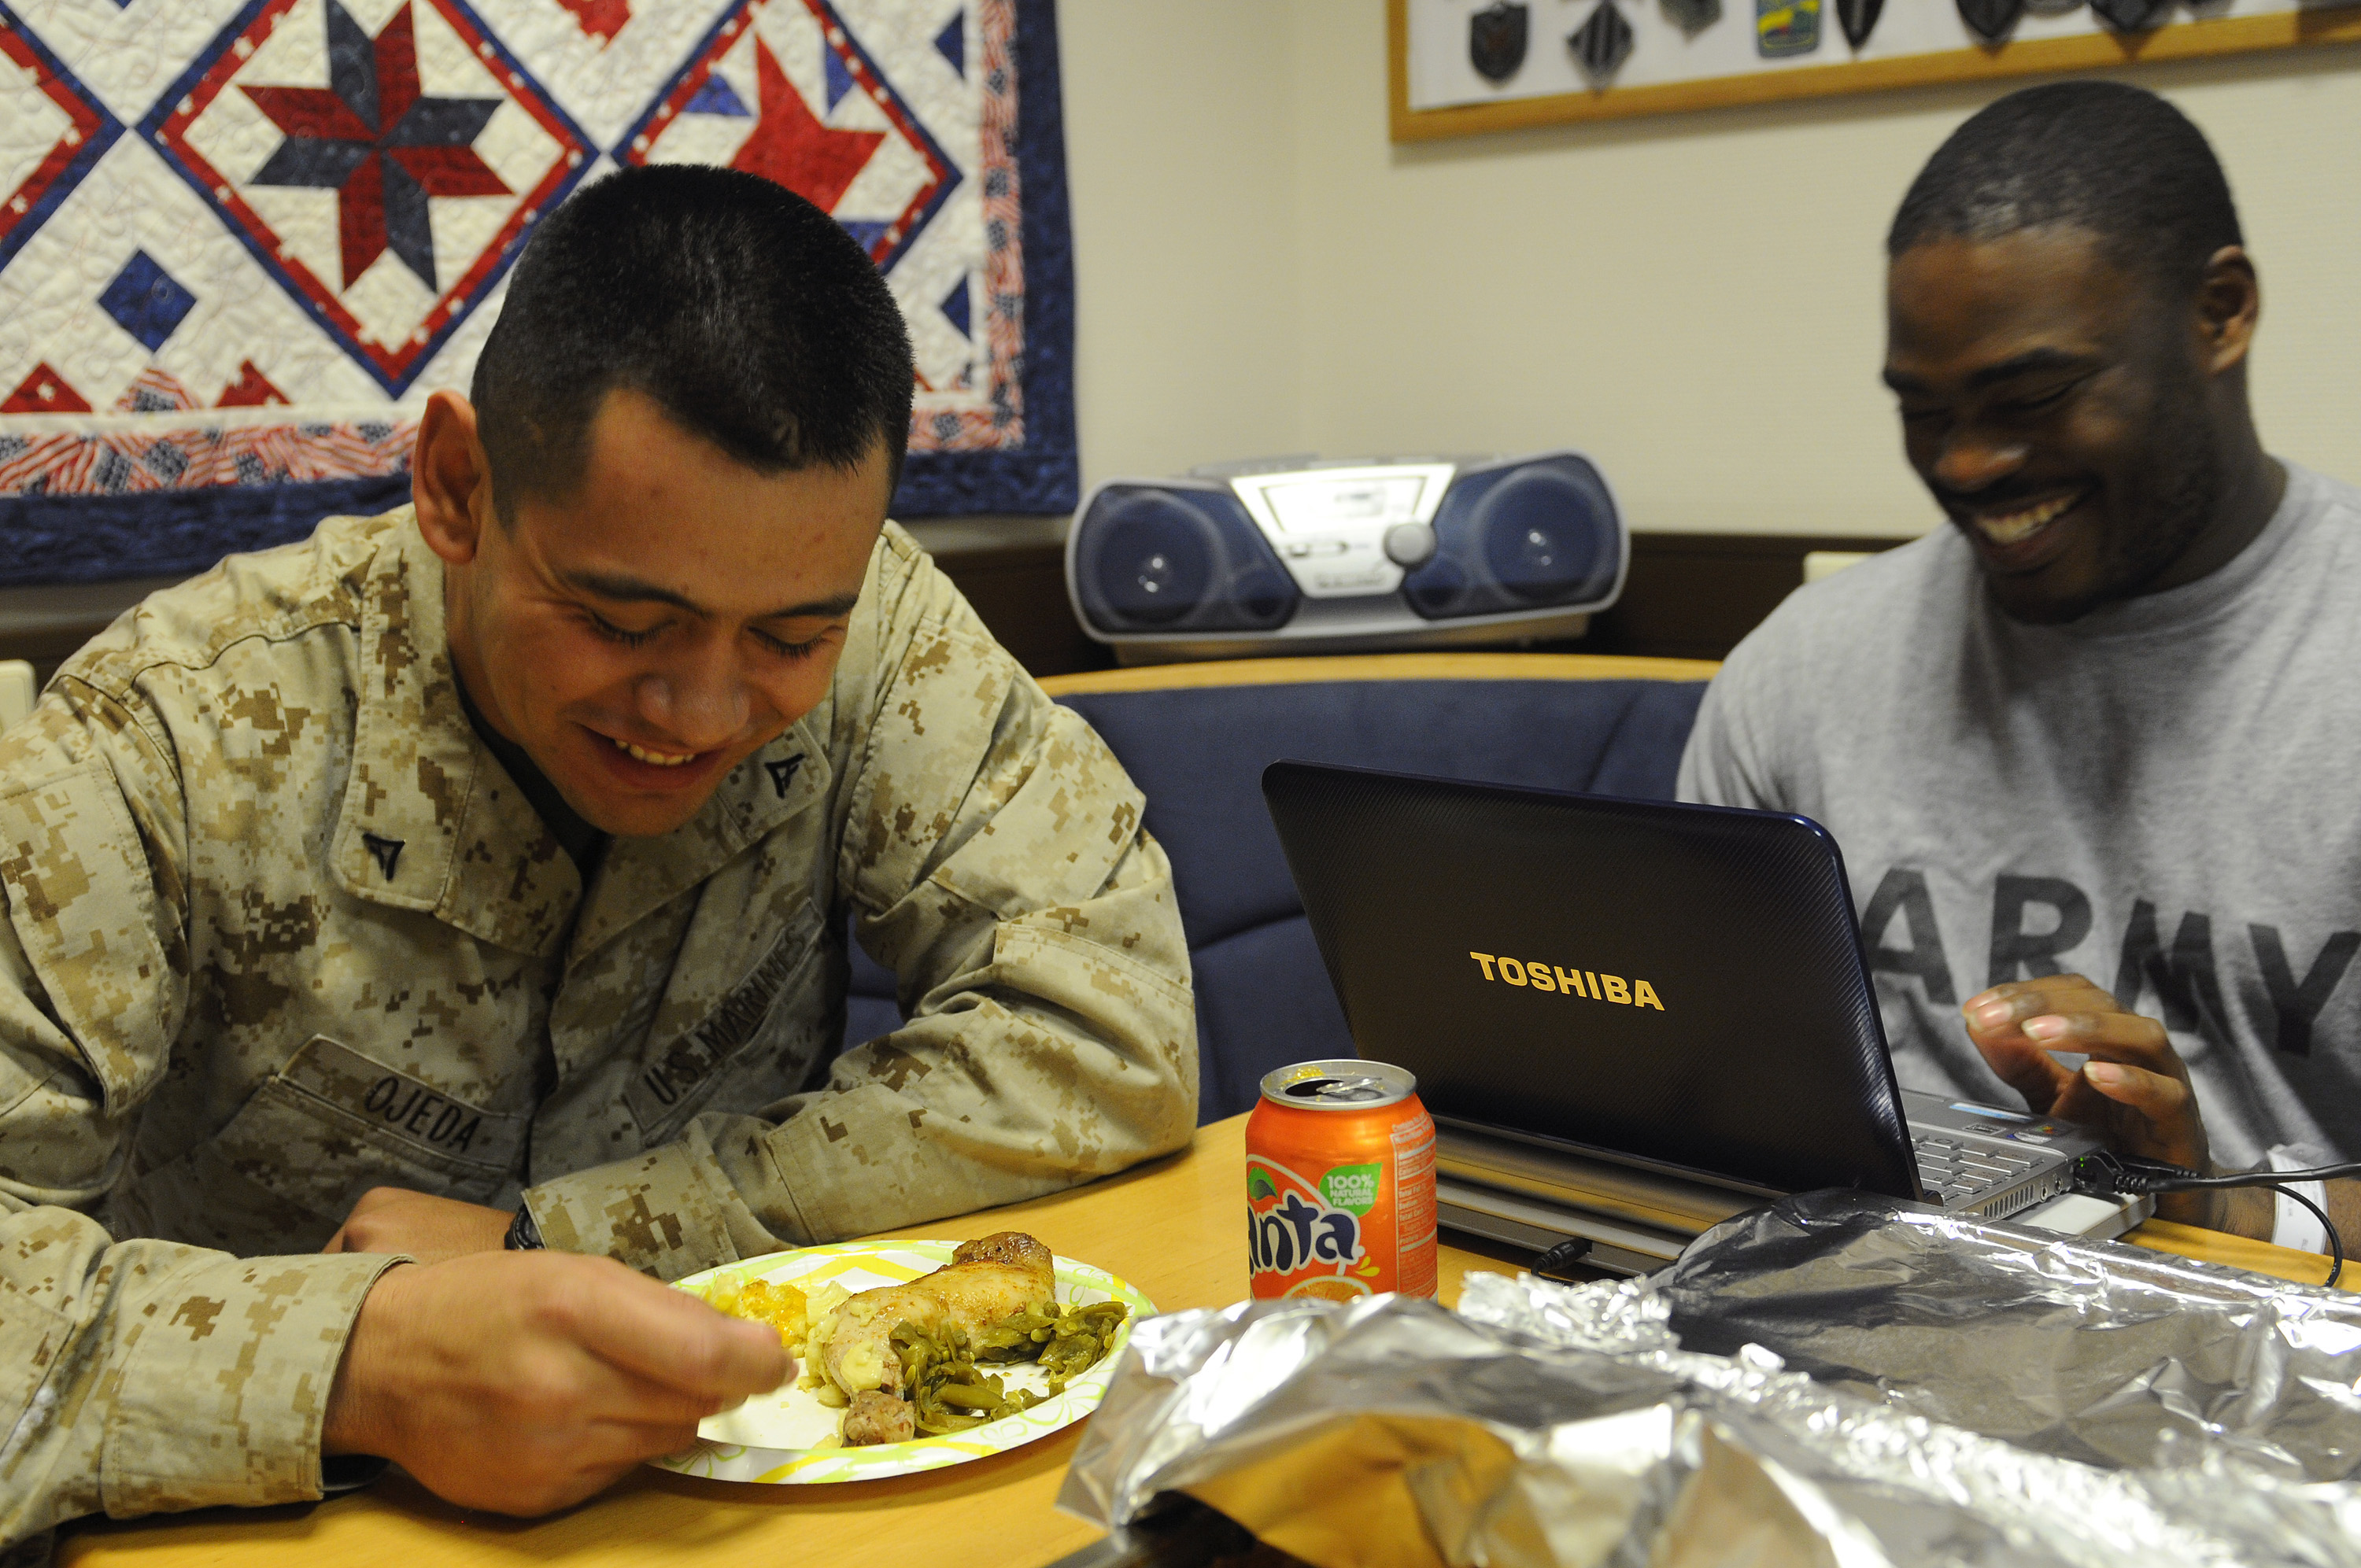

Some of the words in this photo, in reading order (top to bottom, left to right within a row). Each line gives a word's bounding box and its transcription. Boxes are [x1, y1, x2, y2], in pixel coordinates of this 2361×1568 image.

[1469, 951, 1665, 1011] TOSHIBA
[1860, 868, 2361, 1057] ARMY
[364, 1076, 481, 1154] OJEDA
[1327, 1174, 1375, 1190] 100%
[1330, 1188, 1373, 1198] NATURAL
[1332, 1197, 1373, 1206] FLAVORS
[1247, 1194, 1355, 1275] nta
